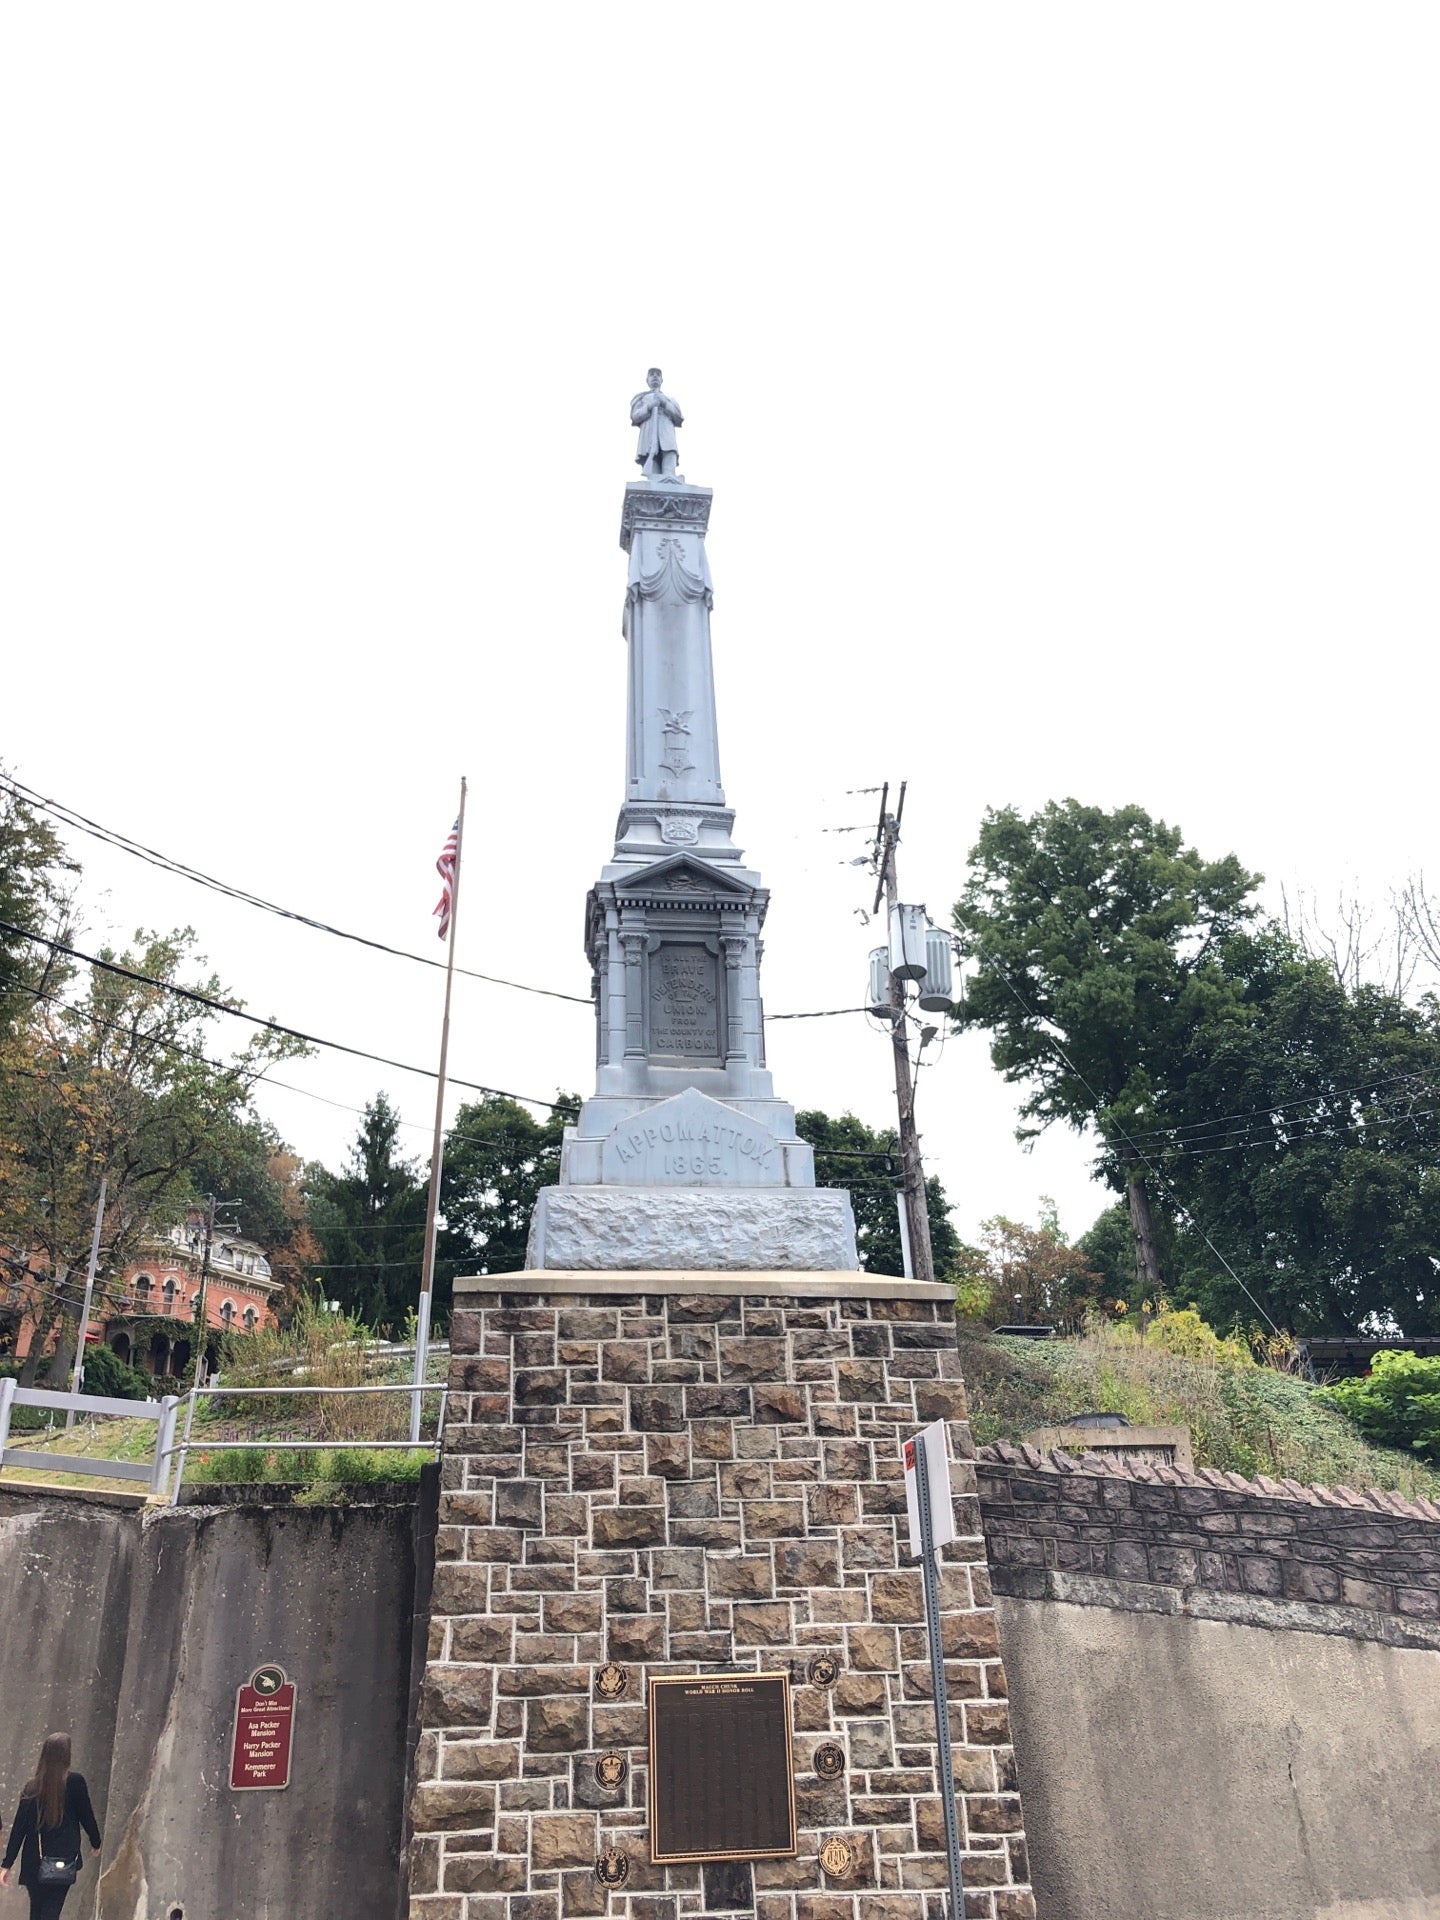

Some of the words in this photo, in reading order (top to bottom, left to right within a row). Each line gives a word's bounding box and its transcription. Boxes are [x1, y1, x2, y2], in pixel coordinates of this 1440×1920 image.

[662, 966, 704, 975] BRAVE
[652, 978, 716, 1003] DEFENDERS
[668, 991, 678, 1000] OF
[682, 990, 697, 1000] THE
[670, 1028, 703, 1036] COUNTY
[656, 1039, 716, 1049] CARBON.
[664, 1155, 728, 1175] 1865.
[260, 1721, 280, 1729] Packer
[251, 1729, 276, 1737] Mansion
[244, 1742, 260, 1750] Harry
[261, 1741, 281, 1749] Packer
[249, 1750, 274, 1758] Mansion
[245, 1763, 276, 1771] Kemmerer
[253, 1770, 266, 1778] Park
